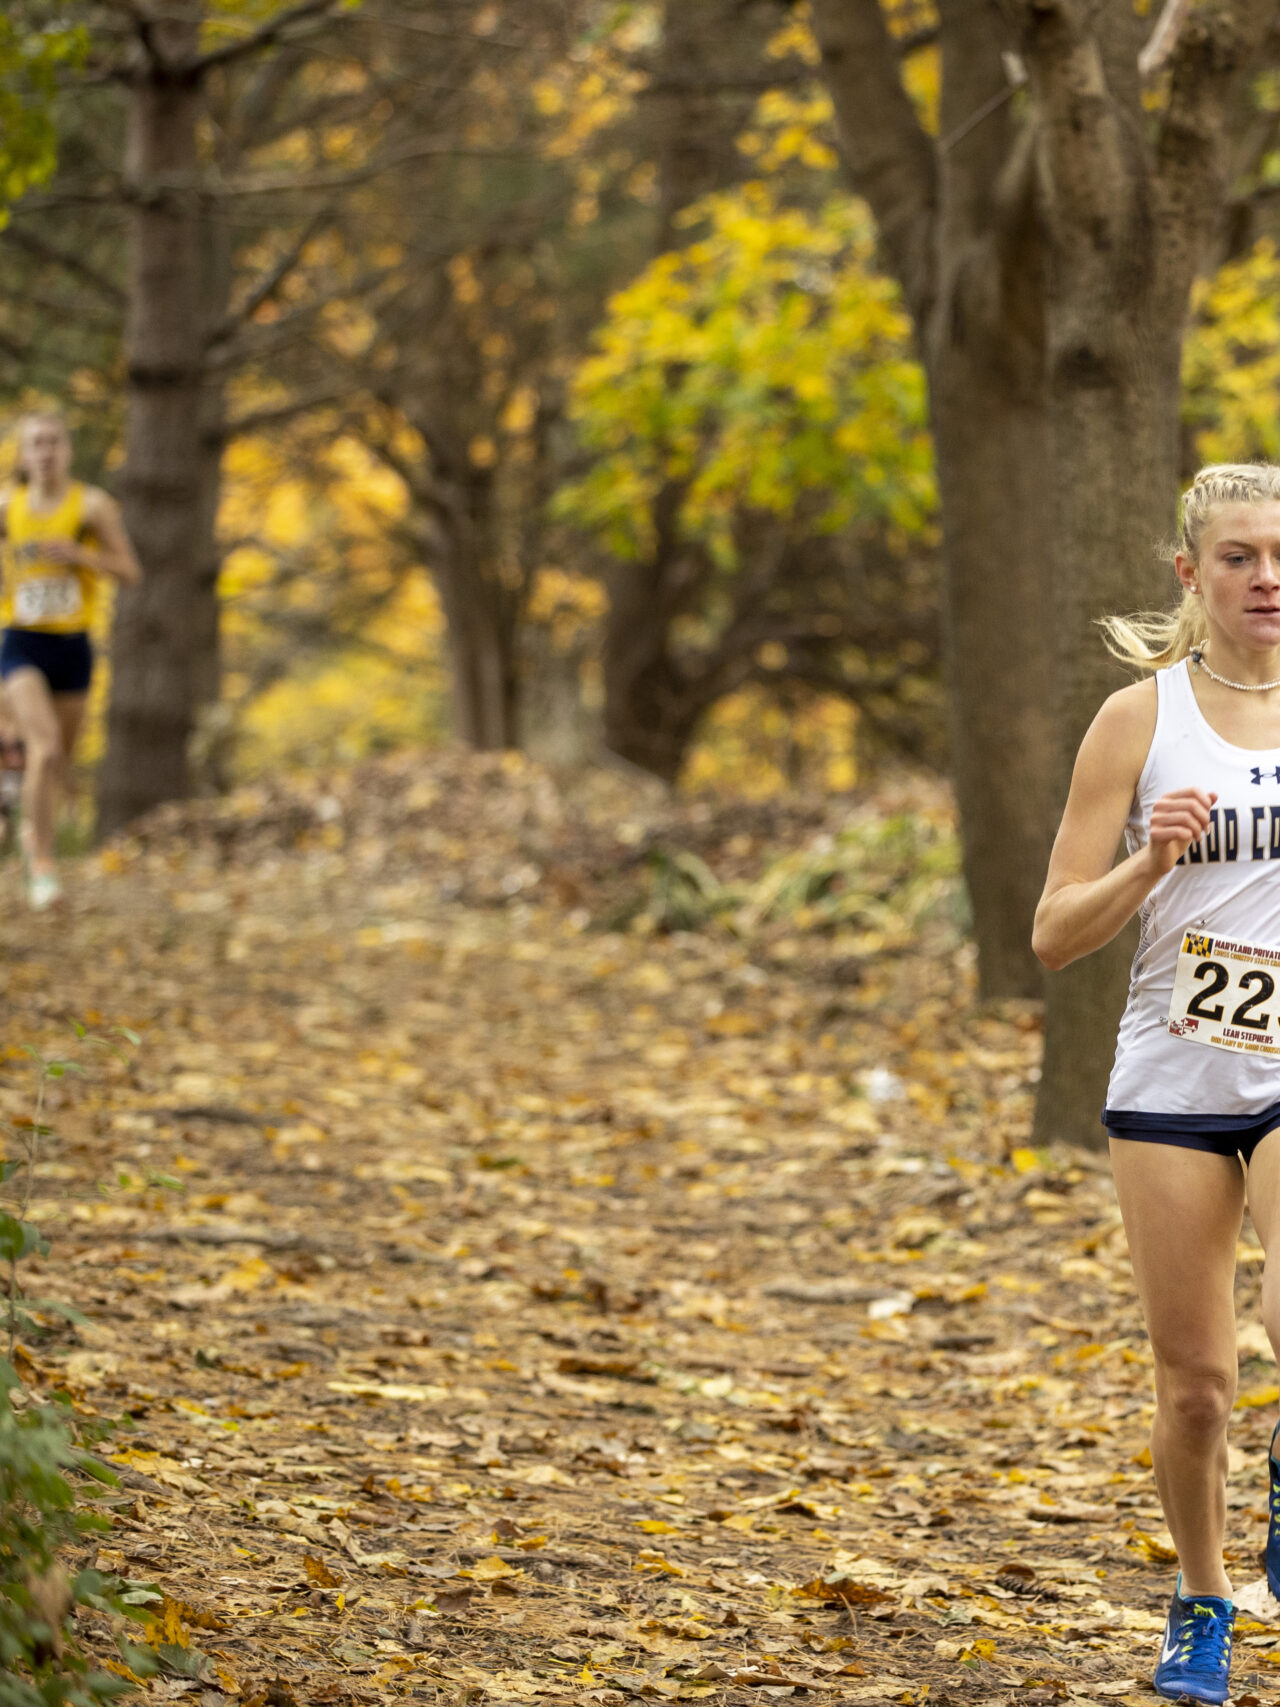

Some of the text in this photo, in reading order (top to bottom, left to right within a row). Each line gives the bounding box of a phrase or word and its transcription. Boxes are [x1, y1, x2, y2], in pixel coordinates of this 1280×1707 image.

[1176, 808, 1239, 865] OD
[1214, 939, 1252, 955] MARYLAND
[1253, 947, 1280, 960] PRIVATE
[1231, 952, 1253, 963] COUNTRY
[1254, 957, 1270, 965] STATE
[1222, 1038, 1236, 1047] LADY
[1223, 1027, 1274, 1044] LEAH STEPHENS
